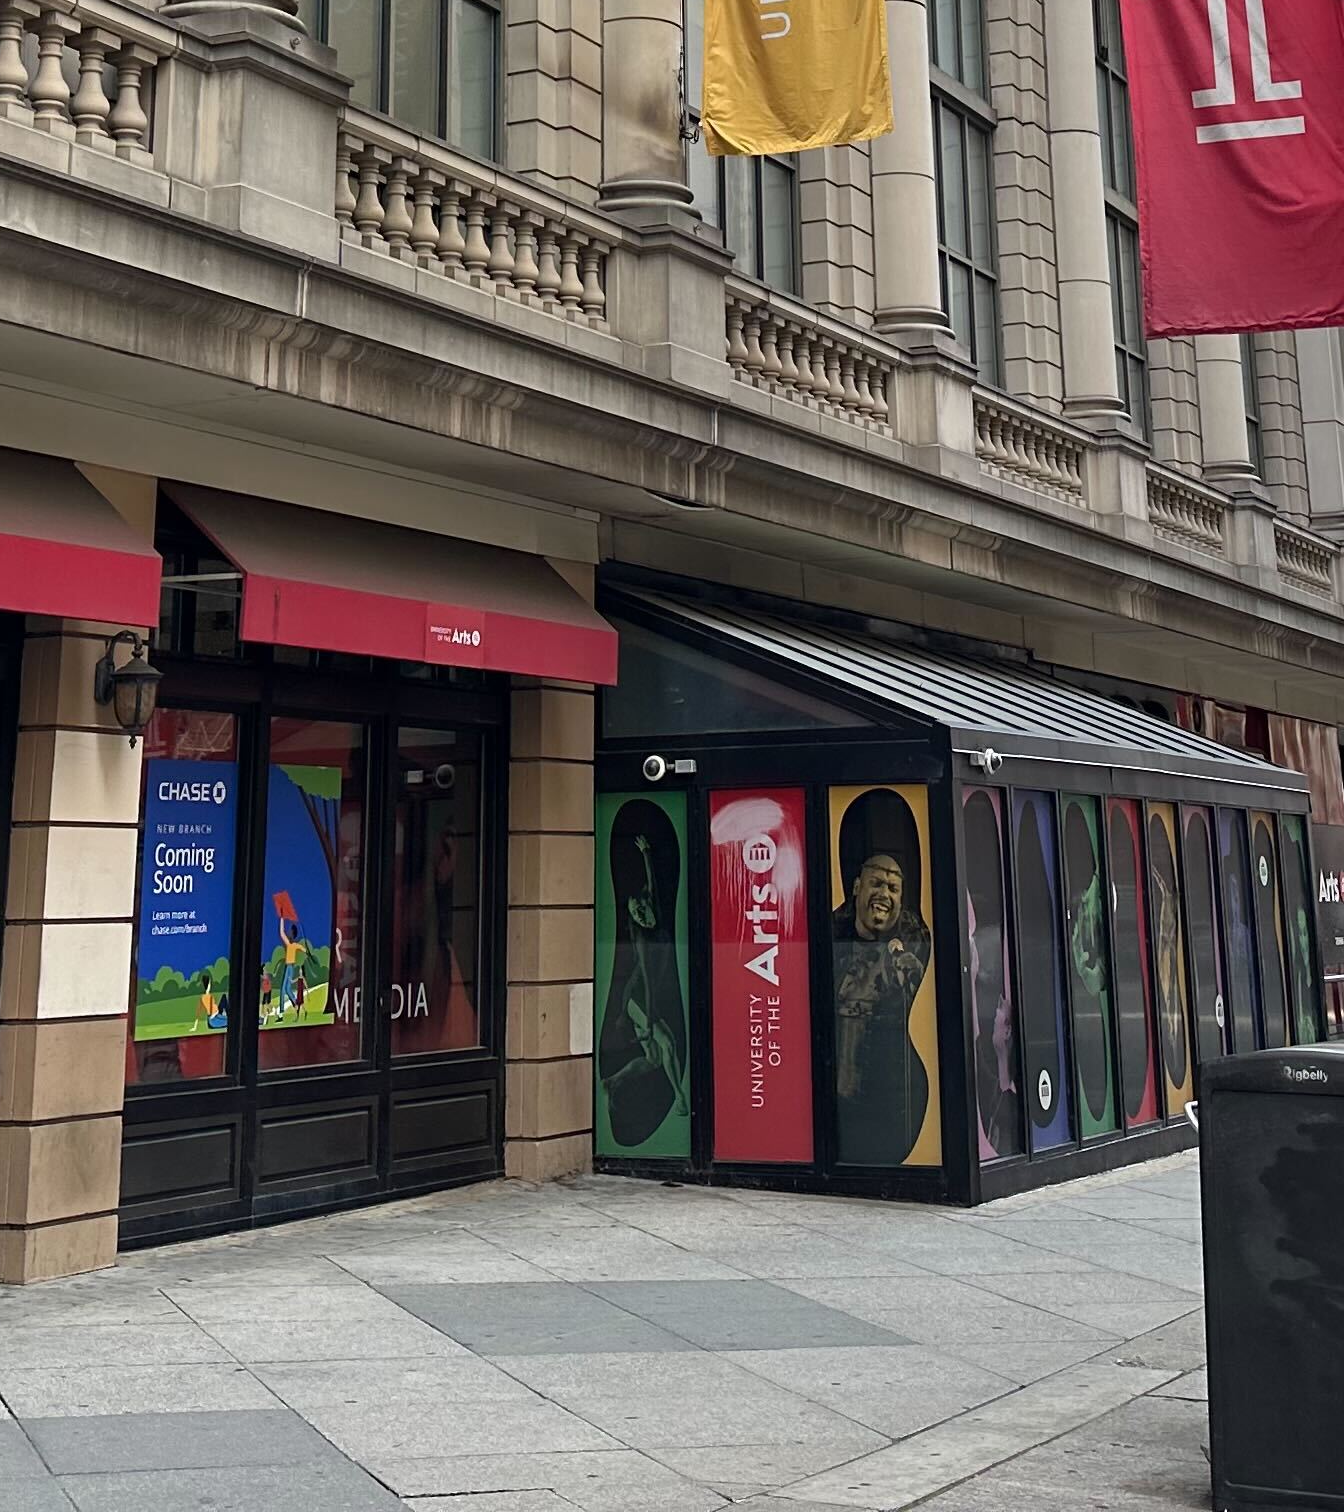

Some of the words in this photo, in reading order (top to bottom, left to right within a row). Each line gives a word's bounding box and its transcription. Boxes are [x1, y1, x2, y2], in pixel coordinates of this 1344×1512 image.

[452, 628, 471, 645] Arts
[159, 781, 211, 801] CHASE
[156, 824, 175, 833] NEW
[178, 824, 212, 834] BRANCH
[155, 842, 215, 873] Coming
[153, 870, 193, 894] Soon
[1318, 868, 1340, 903] Arts
[152, 911, 170, 920] Learn
[189, 910, 196, 919] at
[151, 922, 208, 935] chase.com/branch
[743, 883, 780, 986] Arts
[768, 995, 781, 1035] THE
[750, 993, 764, 1108] UNIVERSITY
[768, 1038, 781, 1067] OF
